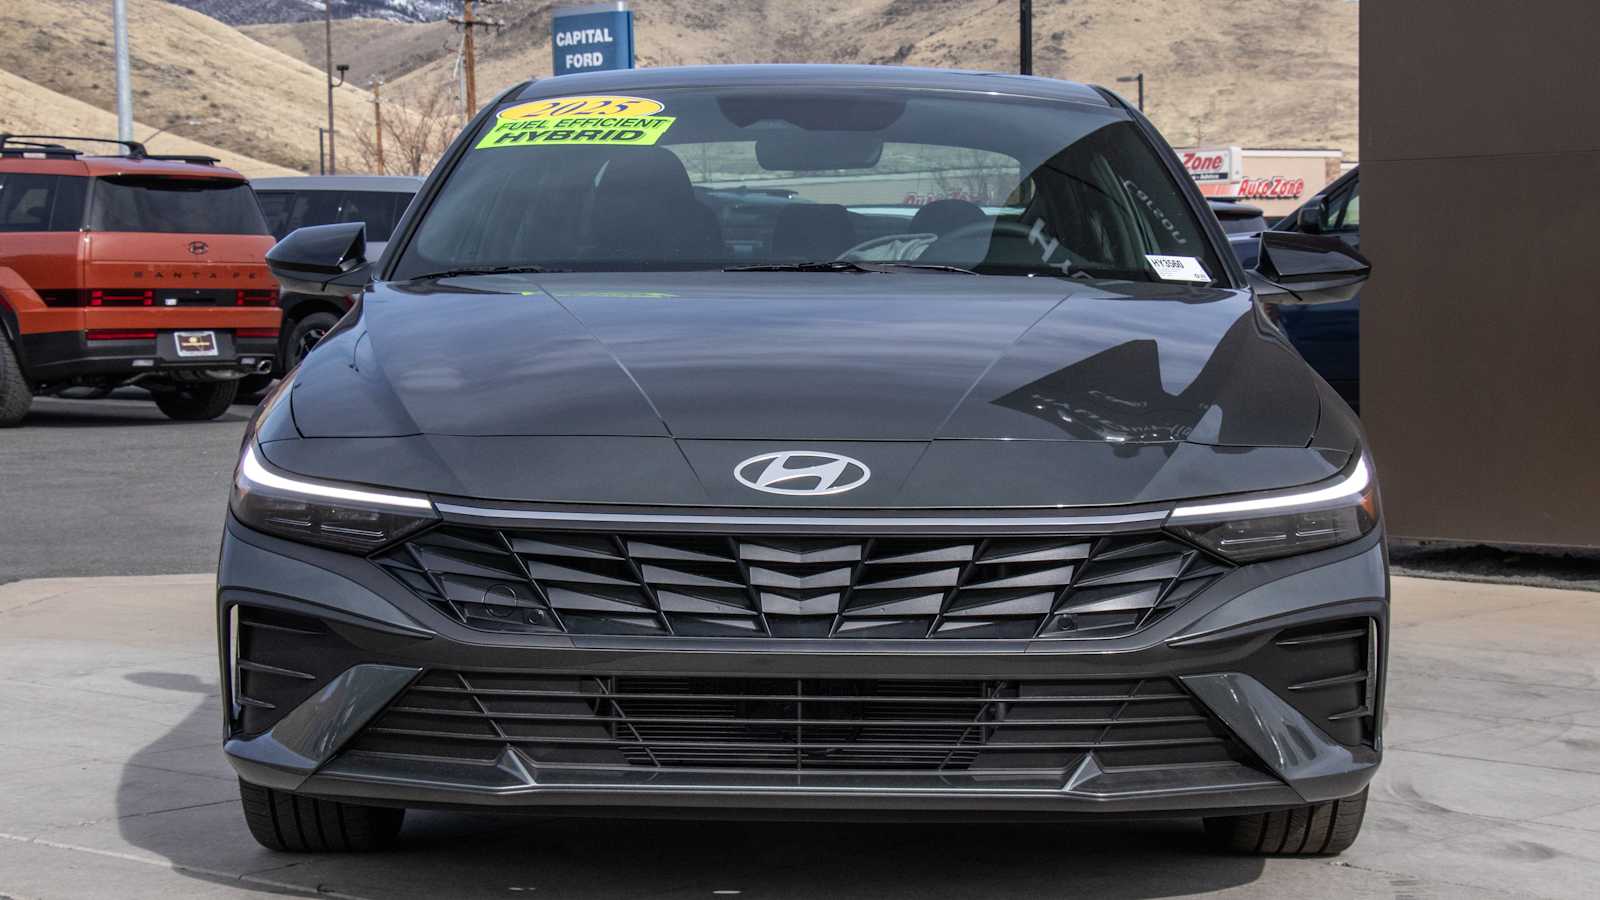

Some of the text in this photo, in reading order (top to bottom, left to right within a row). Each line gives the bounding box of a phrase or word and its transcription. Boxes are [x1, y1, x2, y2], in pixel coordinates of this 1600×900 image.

[556, 28, 613, 47] CAPITAL
[565, 52, 603, 69] FORD
[523, 100, 641, 118] 2025
[497, 117, 667, 131] FUEL EFFICIENT
[495, 129, 645, 144] HYBRID
[133, 271, 217, 279] SANTA
